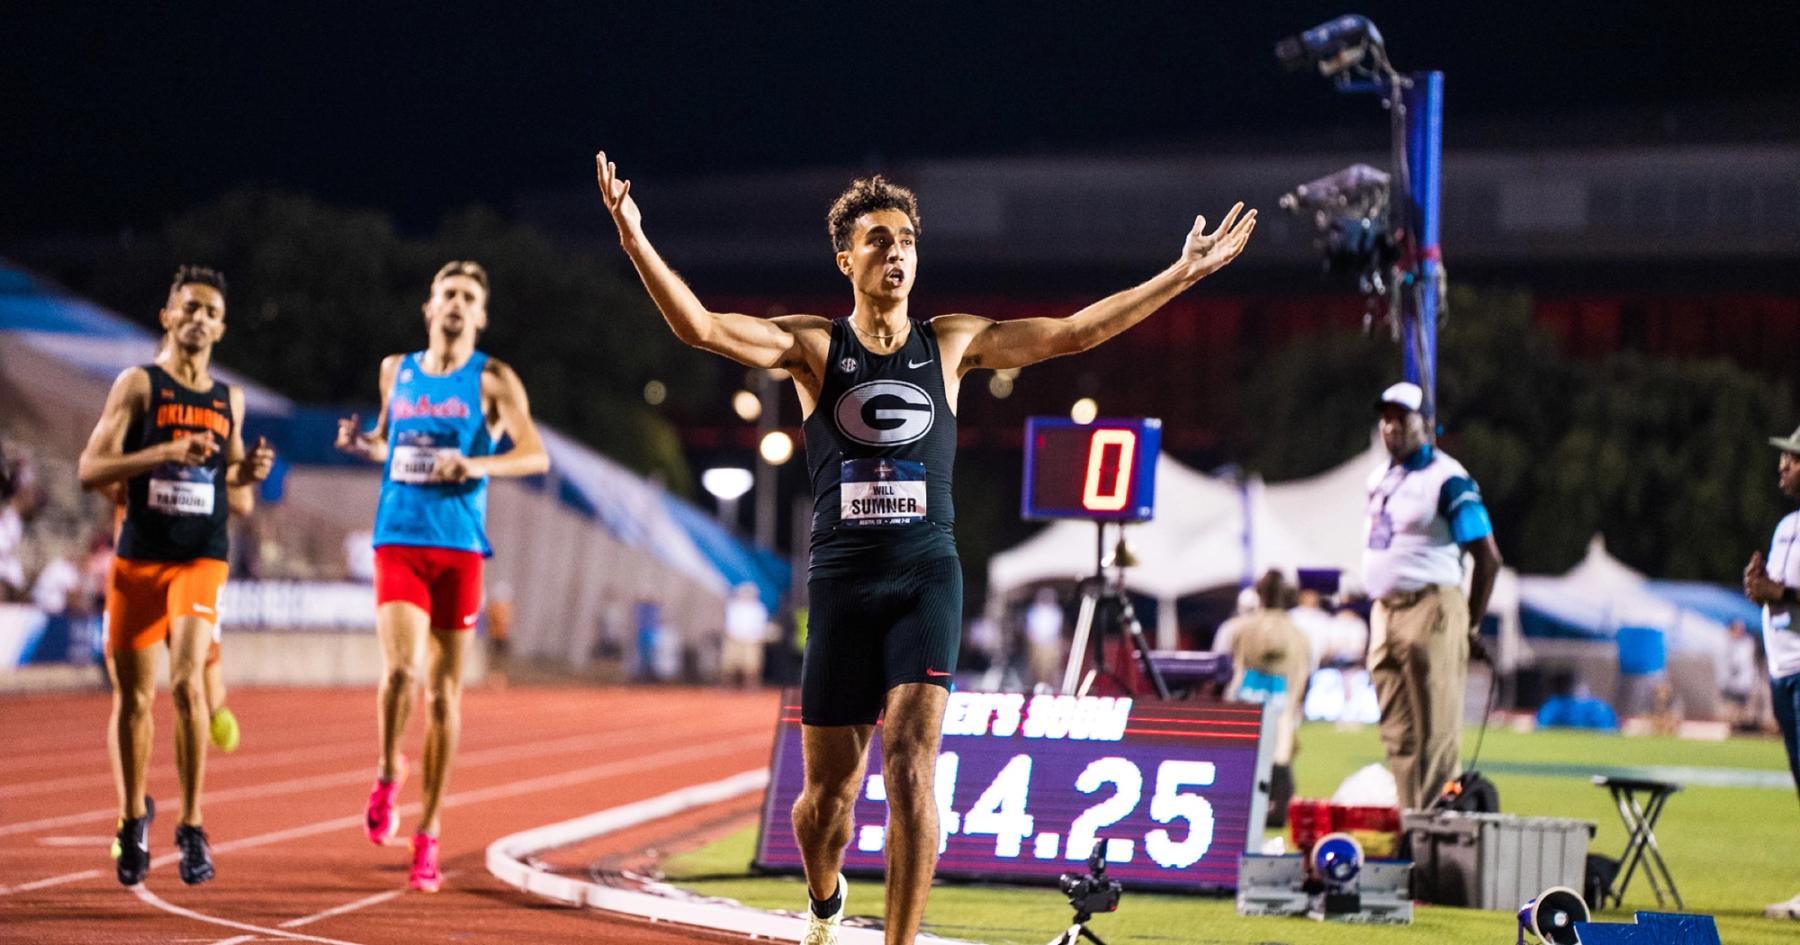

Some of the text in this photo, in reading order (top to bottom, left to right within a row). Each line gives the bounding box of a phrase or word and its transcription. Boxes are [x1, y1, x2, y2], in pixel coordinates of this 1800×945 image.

[834, 380, 935, 447] G
[873, 486, 894, 496] WILL
[1083, 429, 1136, 511] 0
[851, 498, 917, 514] SUMNER
[942, 692, 1133, 742] EN'S 800M
